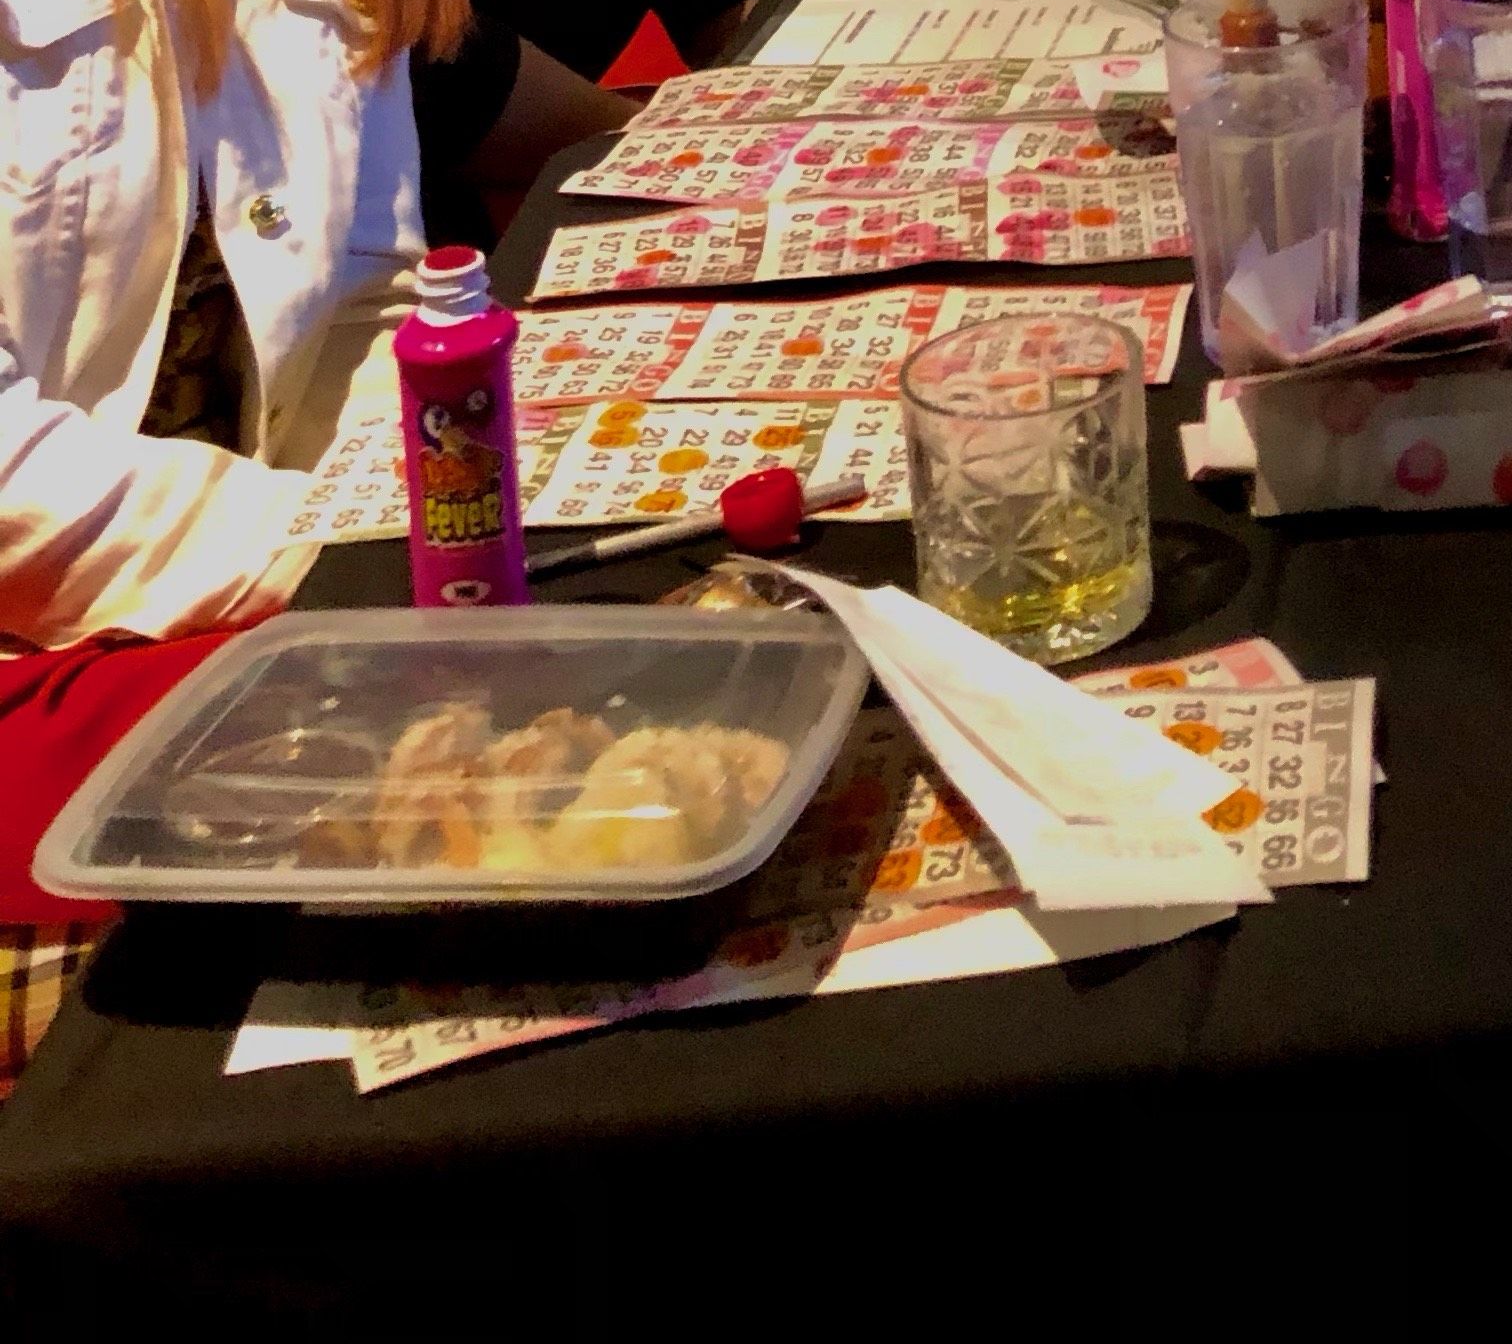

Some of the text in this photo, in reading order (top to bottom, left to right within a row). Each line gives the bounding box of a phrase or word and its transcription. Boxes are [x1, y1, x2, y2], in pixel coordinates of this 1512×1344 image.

[556, 261, 580, 277] 31
[598, 326, 628, 342] 25
[636, 329, 663, 345] 19
[865, 335, 894, 357] 32
[637, 426, 669, 449] 20
[678, 428, 710, 447] 22
[584, 450, 613, 472] 41
[625, 450, 658, 475] 34
[1173, 700, 1208, 722] 13
[1225, 704, 1258, 717] 7
[1271, 719, 1305, 746] 27
[1267, 753, 1303, 791] 32
[1304, 691, 1350, 863] BINGO
[1261, 833, 1298, 871] 66
[925, 846, 965, 882] 73
